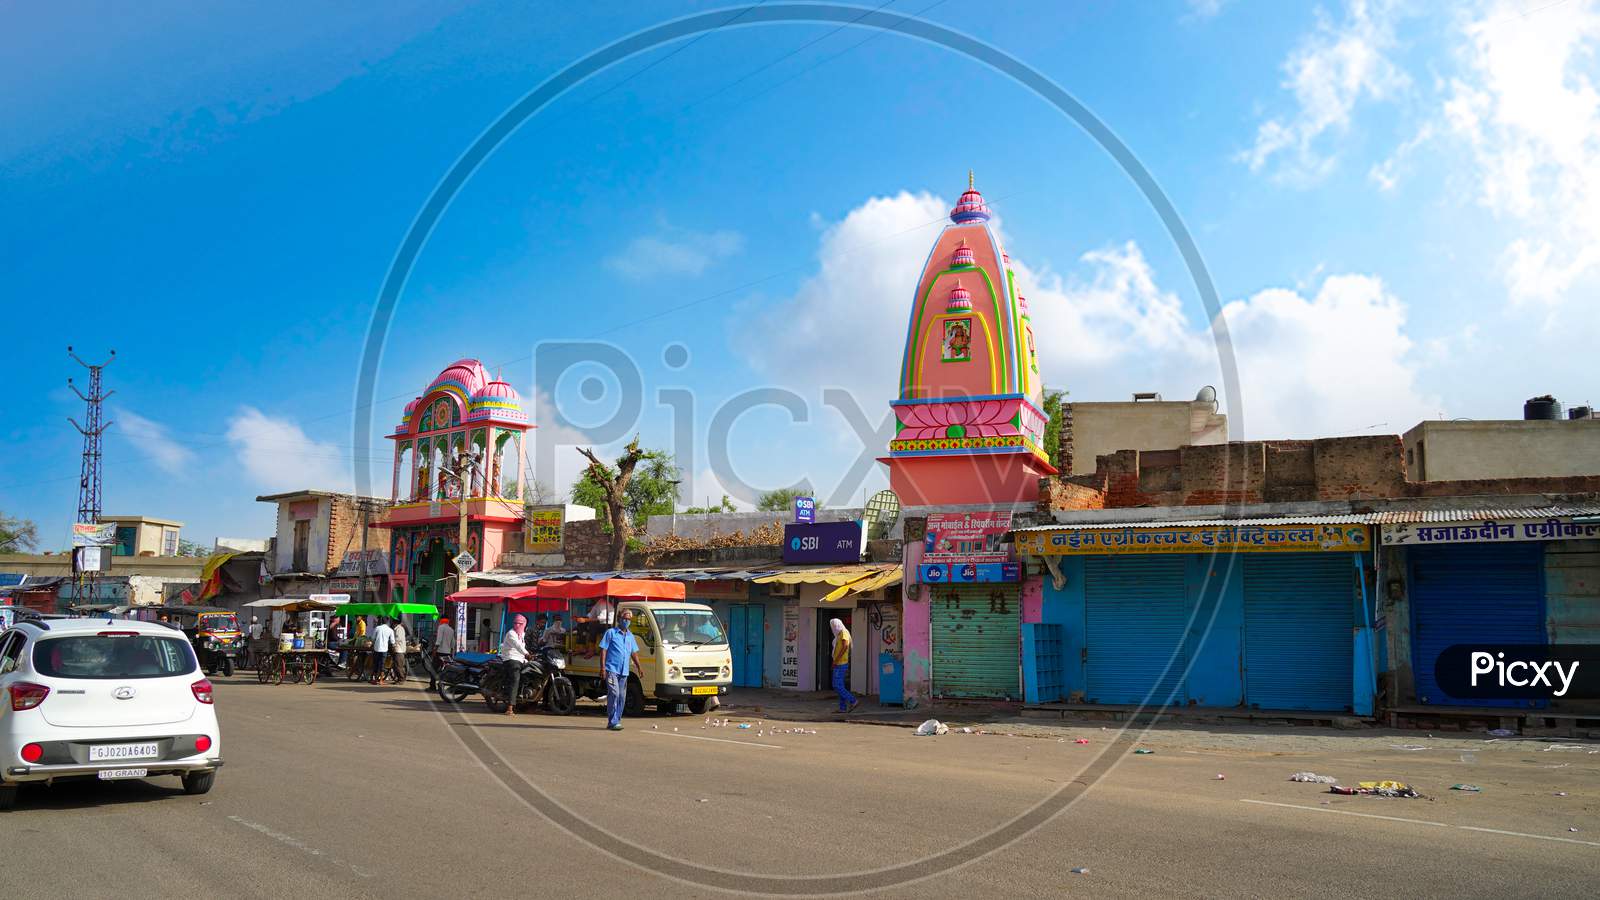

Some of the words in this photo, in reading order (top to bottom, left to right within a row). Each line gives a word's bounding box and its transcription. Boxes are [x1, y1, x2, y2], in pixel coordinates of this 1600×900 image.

[802, 500, 813, 509] SBI
[1052, 528, 1096, 547] नईम
[1100, 527, 1192, 546] एग्रीकल्चर
[801, 536, 819, 550] SBI
[836, 540, 853, 549] ATM
[928, 569, 940, 578] Jio
[962, 569, 974, 577] Jio
[783, 657, 798, 665] LIFE
[782, 669, 798, 677] CARE
[97, 745, 157, 757] GJ02DA6409
[115, 769, 147, 777] GRAND
